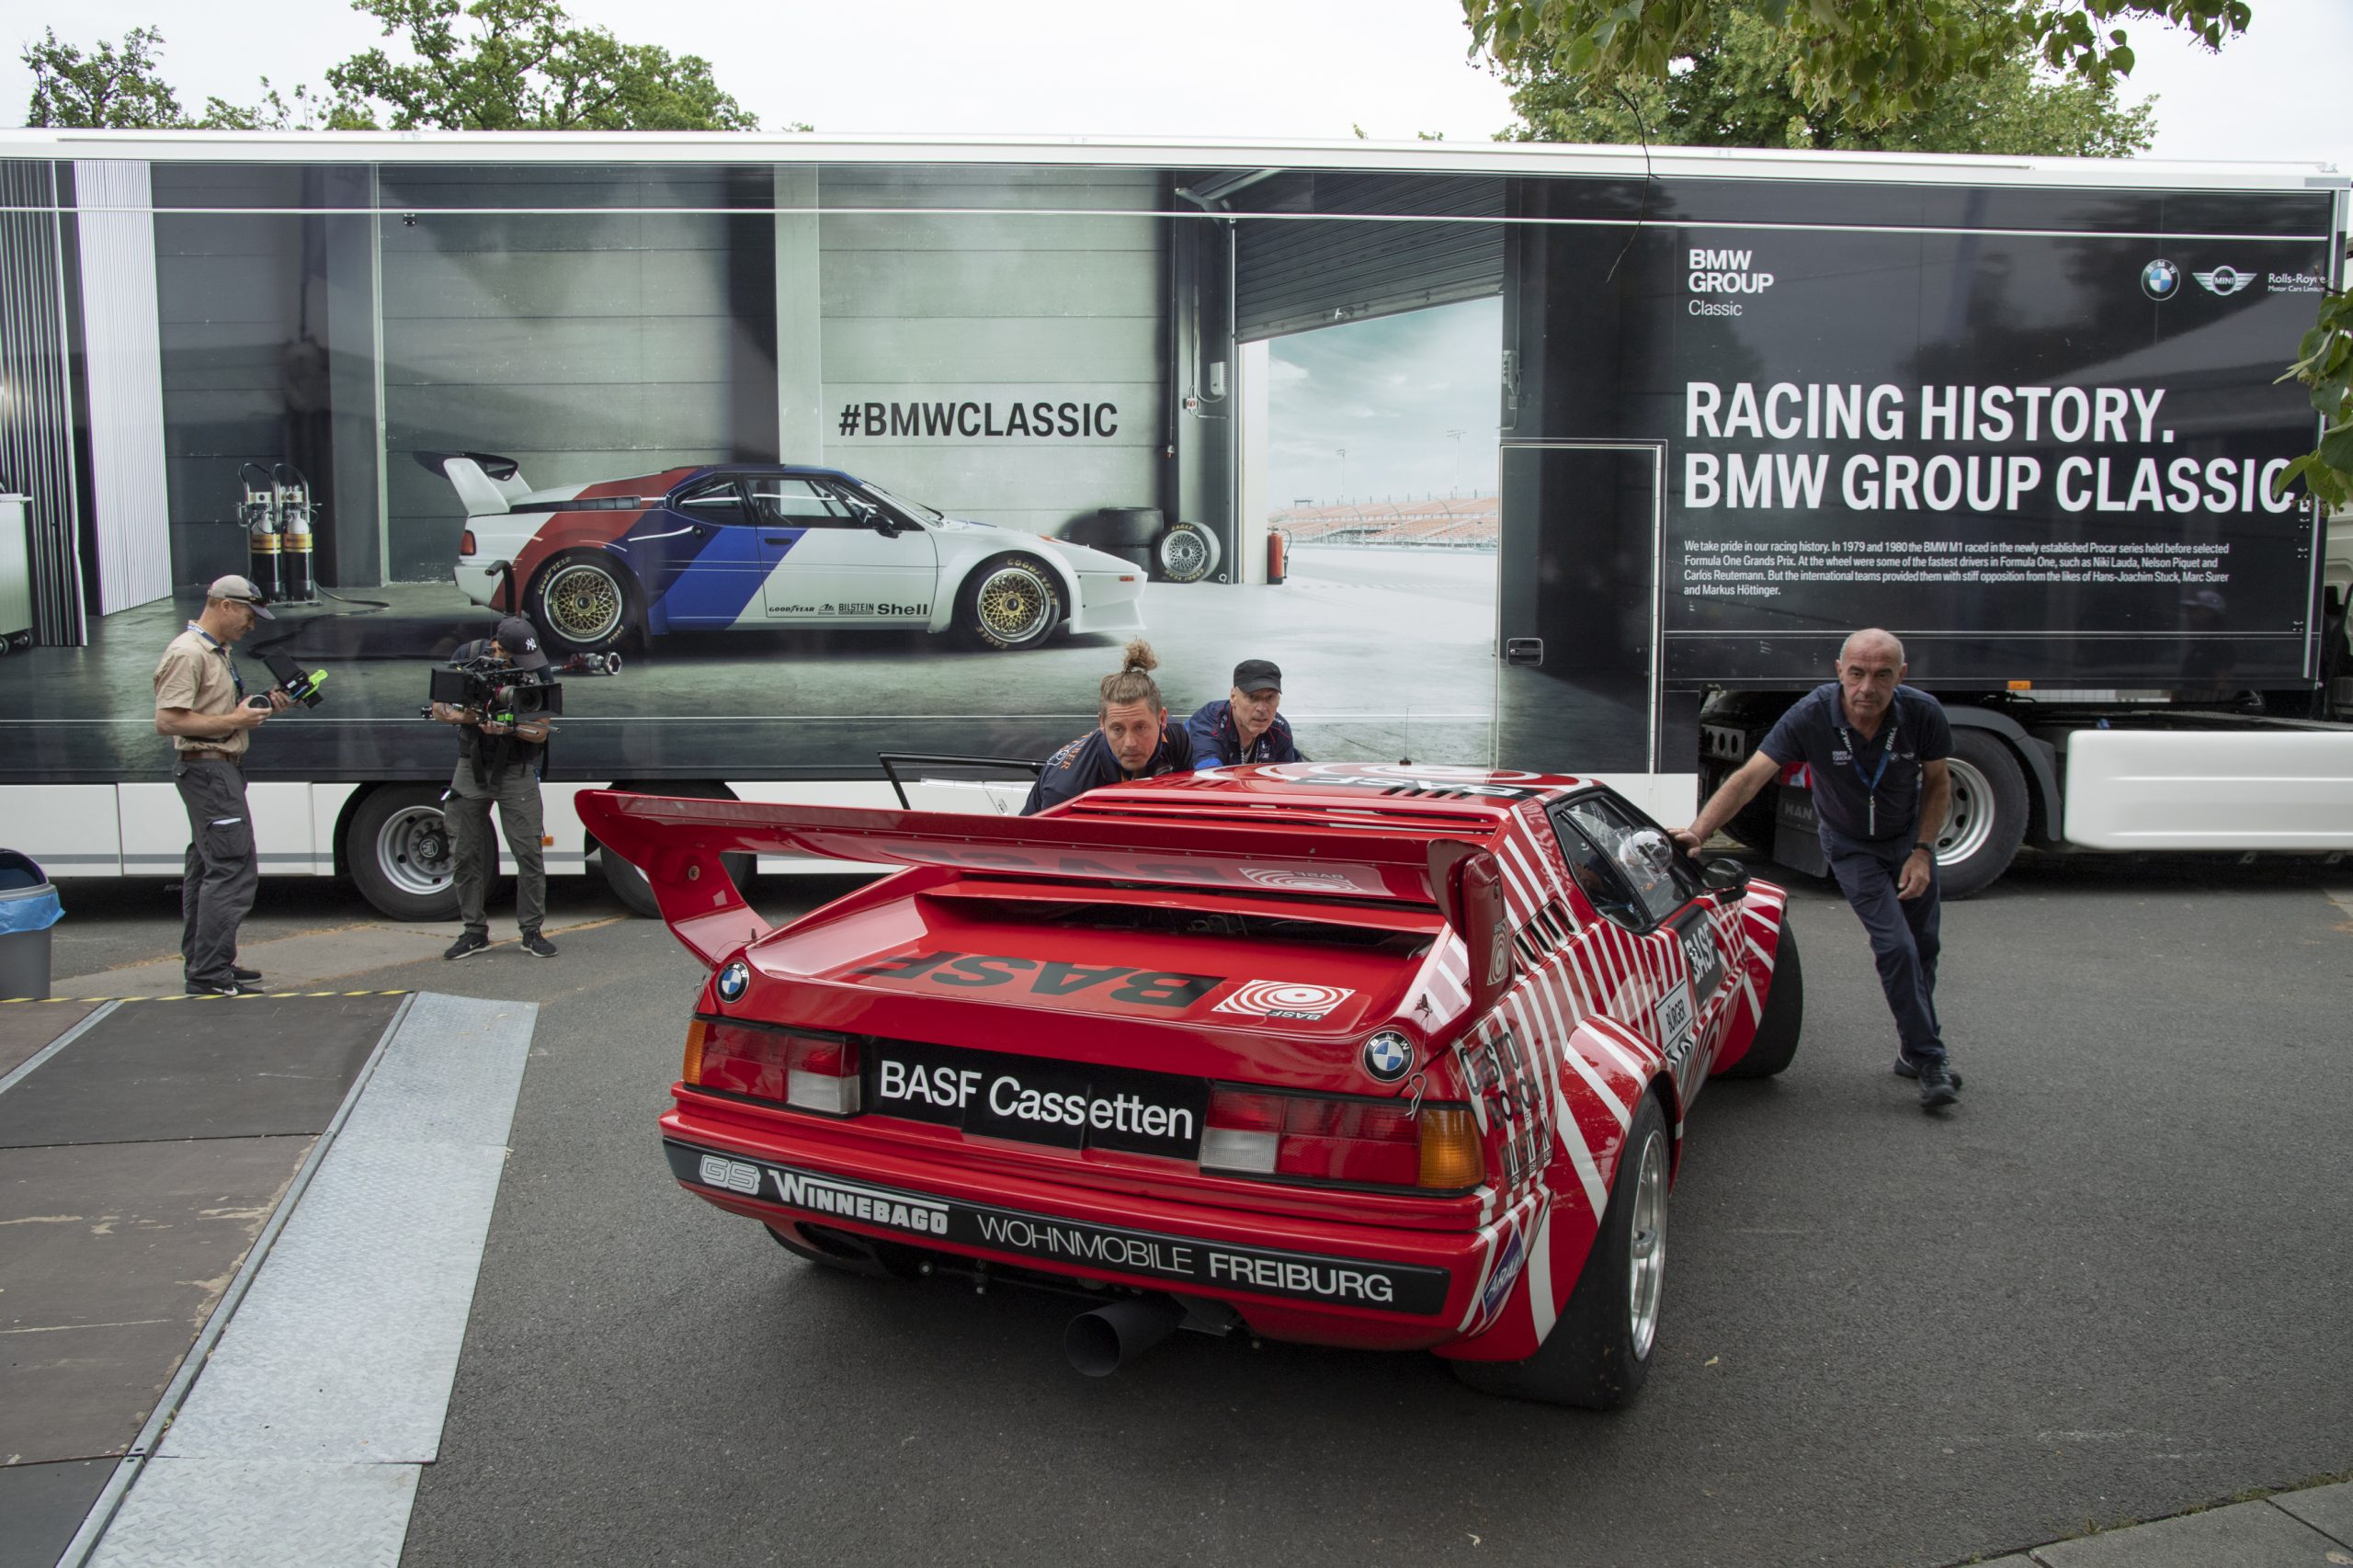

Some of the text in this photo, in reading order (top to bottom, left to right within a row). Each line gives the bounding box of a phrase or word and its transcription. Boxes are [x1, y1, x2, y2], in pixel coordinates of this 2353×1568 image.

[1688, 249, 1753, 270] BMW
[1688, 271, 1774, 293] GROUP
[2213, 277, 2234, 285] MINI
[1688, 300, 1743, 316] Classic
[838, 402, 1120, 438] #BMWCLASSIC
[1685, 382, 2176, 444] RACING HISTORY.
[1684, 453, 1830, 510] BMW
[1841, 454, 2041, 512] GROUP
[1685, 540, 2229, 555] We take pride in our racing history. In 1979 and 1980 the BMW M1 raced in the newly established Procar series held before selected
[1685, 555, 2218, 570] Formula One Grands Prix. At the wheel were some of the fastest drivers in Formula One, such as Niki Lauda, Nelson Piquet and
[1684, 570, 2229, 585] Carlos Reutemann. But the international teams provided them with stiff opposition from the likes of Hans-Joachim Stuck, Marc Surer
[1684, 585, 1781, 597] and Markus Höttinger.
[838, 603, 874, 611] BILSTEIN
[877, 603, 928, 616] Shell
[1784, 802, 1813, 821] MAN
[1685, 922, 1716, 985] BASF
[853, 951, 1229, 1008] BASF
[1269, 1010, 1323, 1021] BASF
[1665, 998, 1687, 1034] BÜRGER
[880, 1060, 1194, 1140] BASF Cassetten
[767, 1168, 949, 1235] WINNEBAGO
[977, 1213, 1195, 1275] WOHNMOBILE
[1209, 1252, 1393, 1302] FREIBURG
[1485, 1256, 1520, 1299] ARAL
